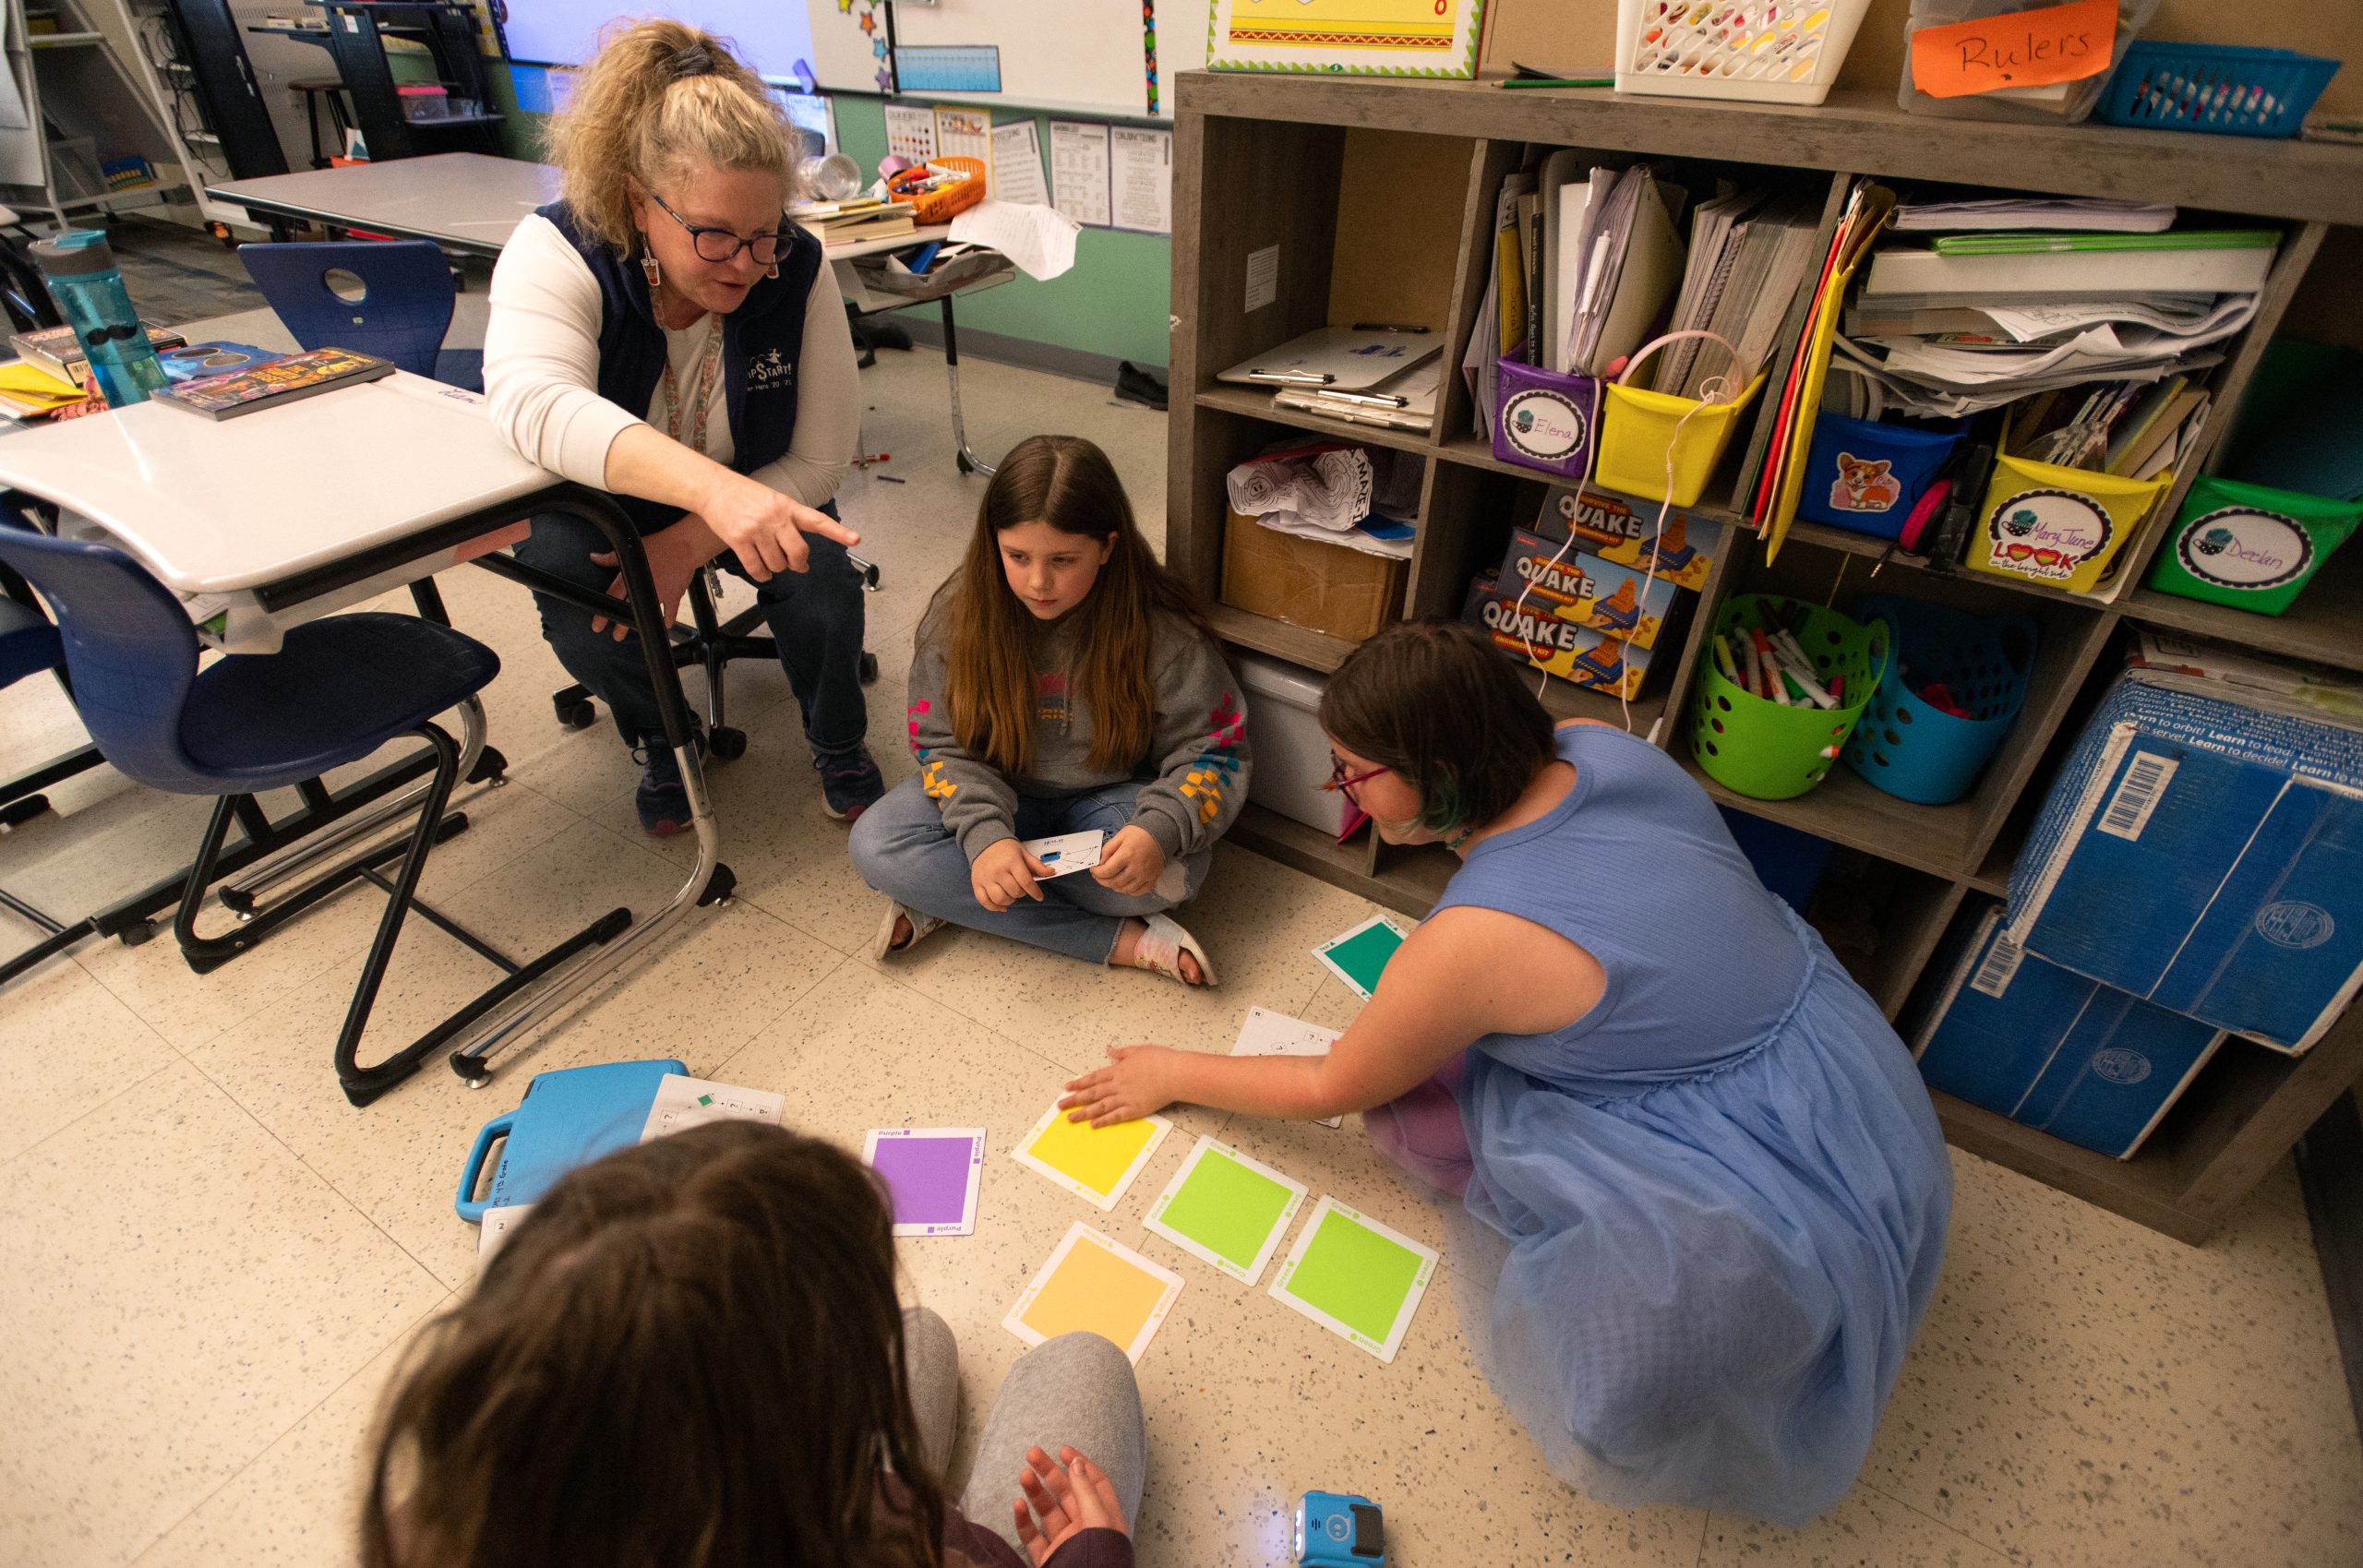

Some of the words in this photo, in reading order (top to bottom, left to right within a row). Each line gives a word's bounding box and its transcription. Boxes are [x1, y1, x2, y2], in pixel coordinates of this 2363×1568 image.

[1955, 30, 2090, 71] Rulers
[1534, 418, 1573, 440] Elena
[1559, 495, 1643, 538] QUAKE
[2225, 537, 2283, 569] Declan
[1517, 557, 1595, 599] QUAKE
[1483, 601, 1577, 651] QUAKE
[2137, 706, 2172, 718] Learn
[2169, 691, 2204, 703] Learn
[2169, 701, 2204, 713] Learn
[2188, 711, 2222, 724] Learn
[2158, 719, 2171, 727] to
[2173, 723, 2205, 736] orbit!
[2208, 729, 2246, 747] Learn
[2249, 739, 2261, 749] to
[2153, 727, 2186, 742] serve!
[2189, 736, 2225, 752] Learn
[2228, 746, 2241, 756] to
[2243, 749, 2289, 767] decide!
[2291, 760, 2332, 778] Learn
[2335, 772, 2348, 784] to
[499, 1160, 509, 1179] Grade
